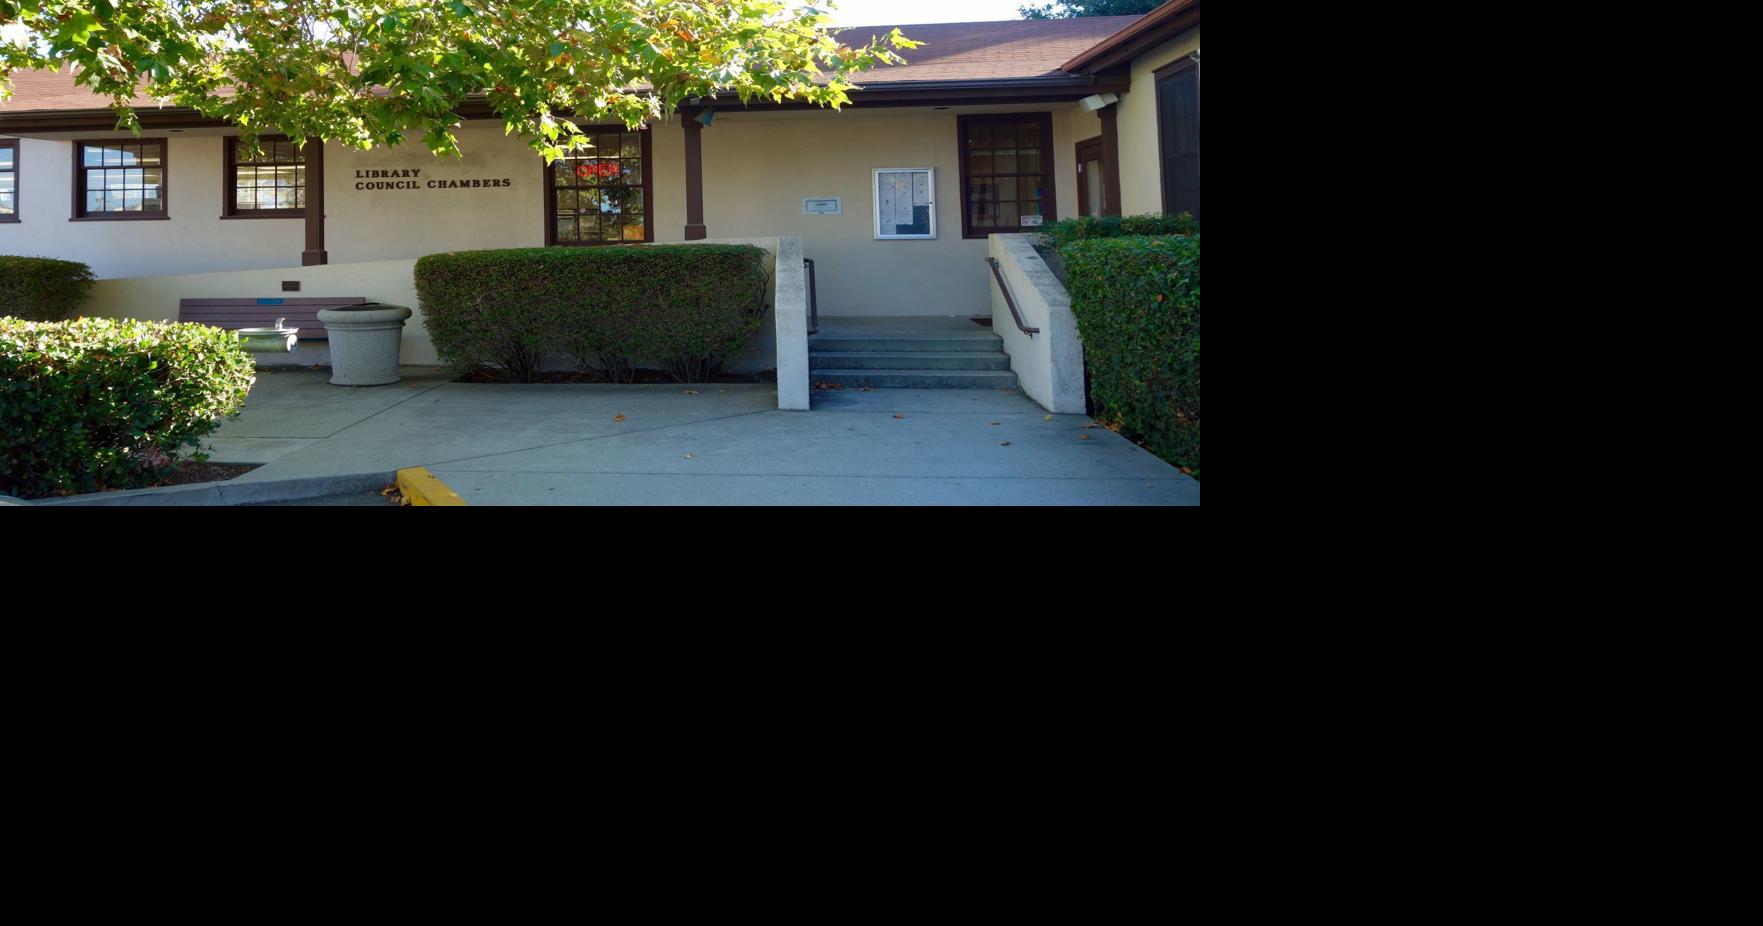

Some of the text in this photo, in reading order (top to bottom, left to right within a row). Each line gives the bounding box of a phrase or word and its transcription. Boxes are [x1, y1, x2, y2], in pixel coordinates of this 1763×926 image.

[355, 169, 421, 179] LIBRARY
[355, 178, 511, 190] COUNCIL CHAMBERS
